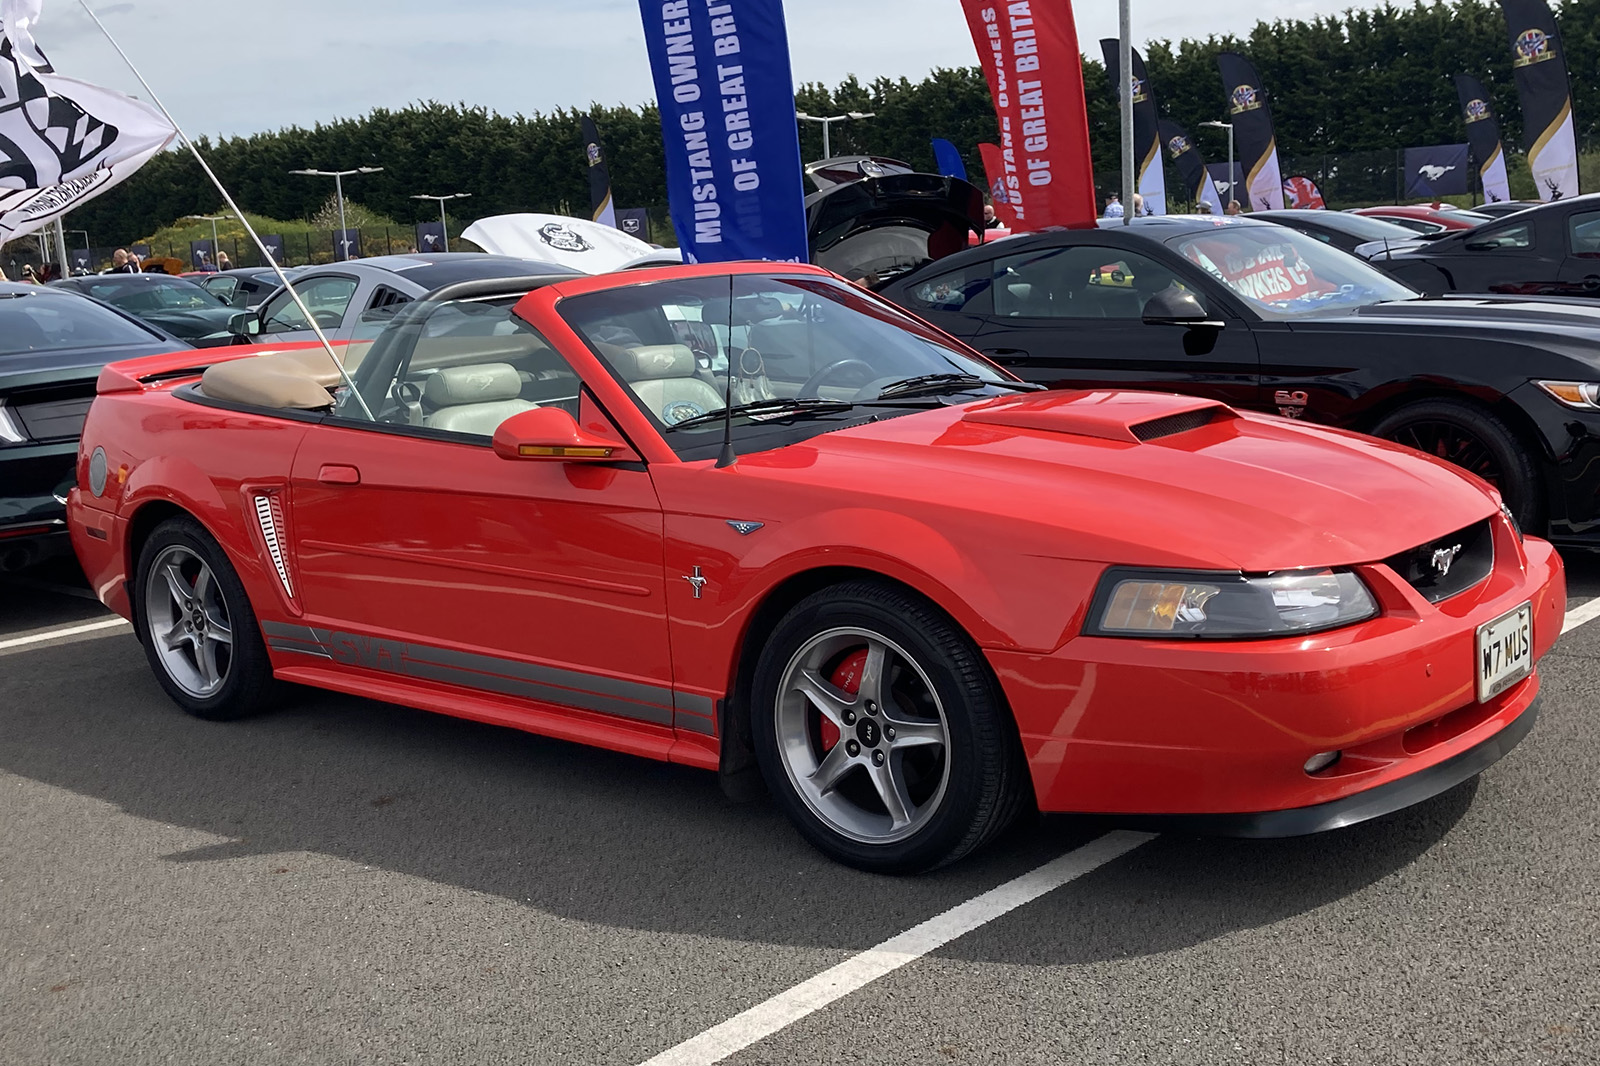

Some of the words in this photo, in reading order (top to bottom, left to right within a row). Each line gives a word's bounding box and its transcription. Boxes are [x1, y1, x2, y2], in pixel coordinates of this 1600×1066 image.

[662, 0, 701, 103] OWNER
[981, 7, 1009, 107] OWNERS
[1006, 0, 1040, 73] BRITA
[716, 64, 755, 152] GREAT
[1016, 79, 1049, 153] GREAT
[680, 111, 722, 243] MUSTANG
[733, 160, 761, 191] OF
[1000, 116, 1025, 220] MUSTANG
[1028, 159, 1052, 187] OF
[330, 630, 408, 673] SVT
[1483, 641, 1501, 680] W7
[1505, 624, 1529, 667] MUS
